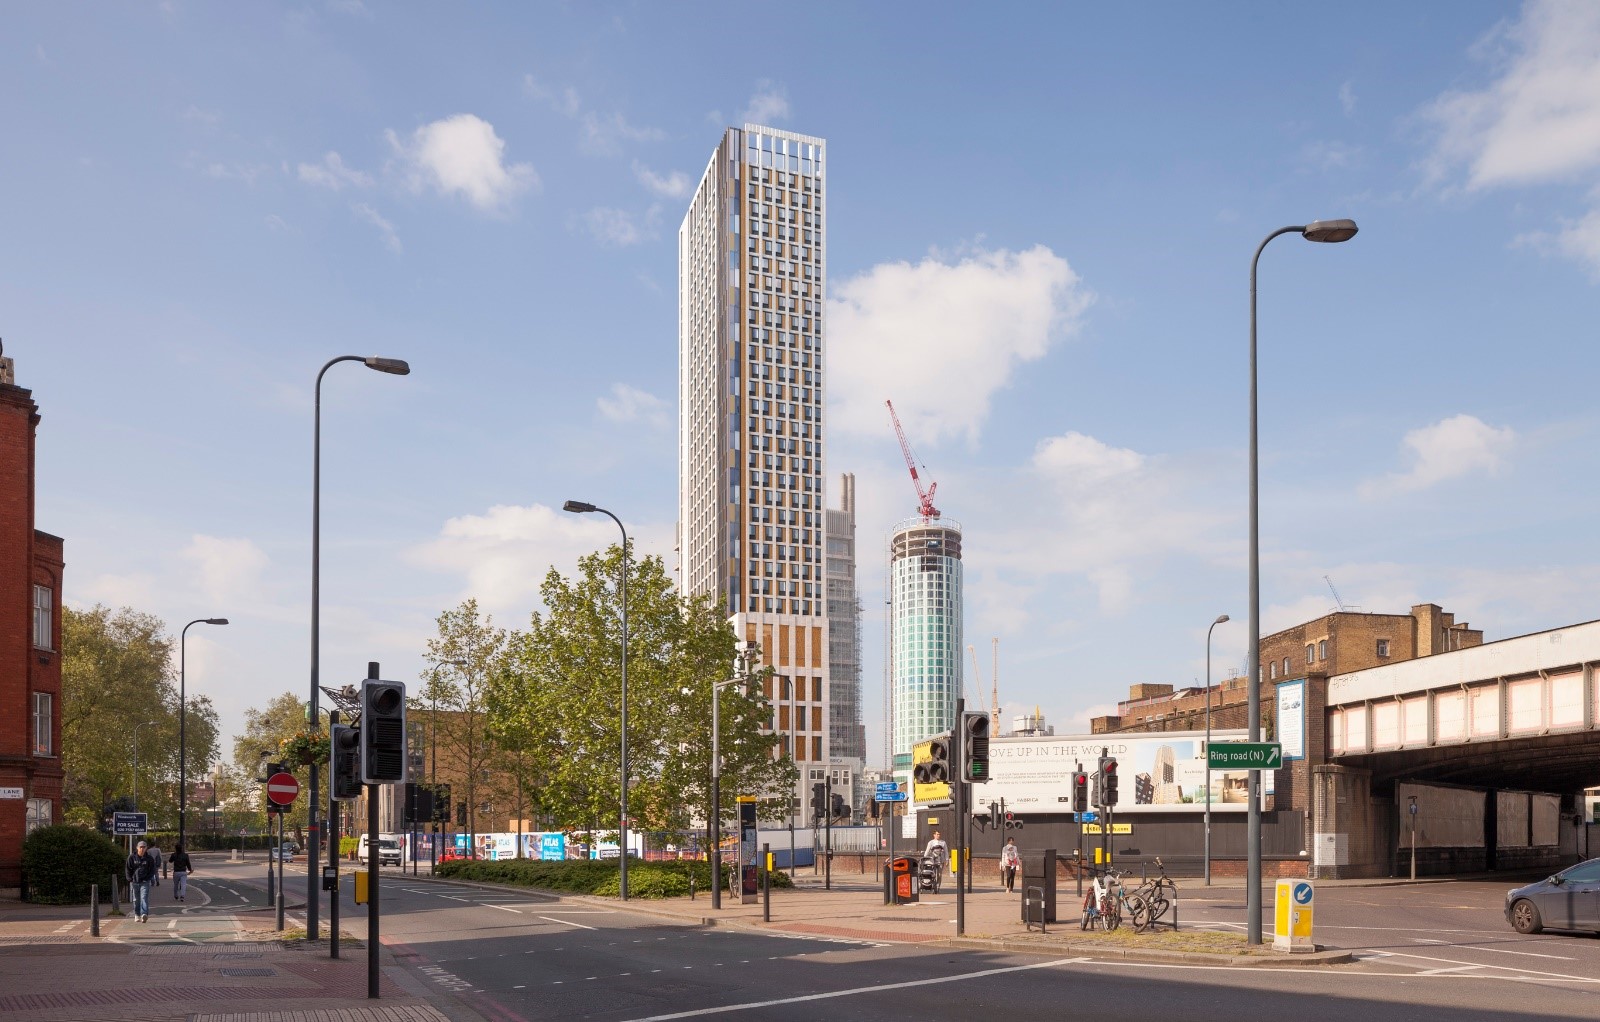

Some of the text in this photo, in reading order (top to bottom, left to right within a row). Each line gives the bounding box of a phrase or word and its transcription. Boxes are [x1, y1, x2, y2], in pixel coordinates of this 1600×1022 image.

[990, 748, 1013, 758] OVE
[1017, 747, 1032, 756] UP
[1036, 746, 1049, 756] IN
[1052, 746, 1078, 756] THE
[1210, 750, 1264, 762] Ring road (N)
[544, 838, 558, 846] ATLAS
